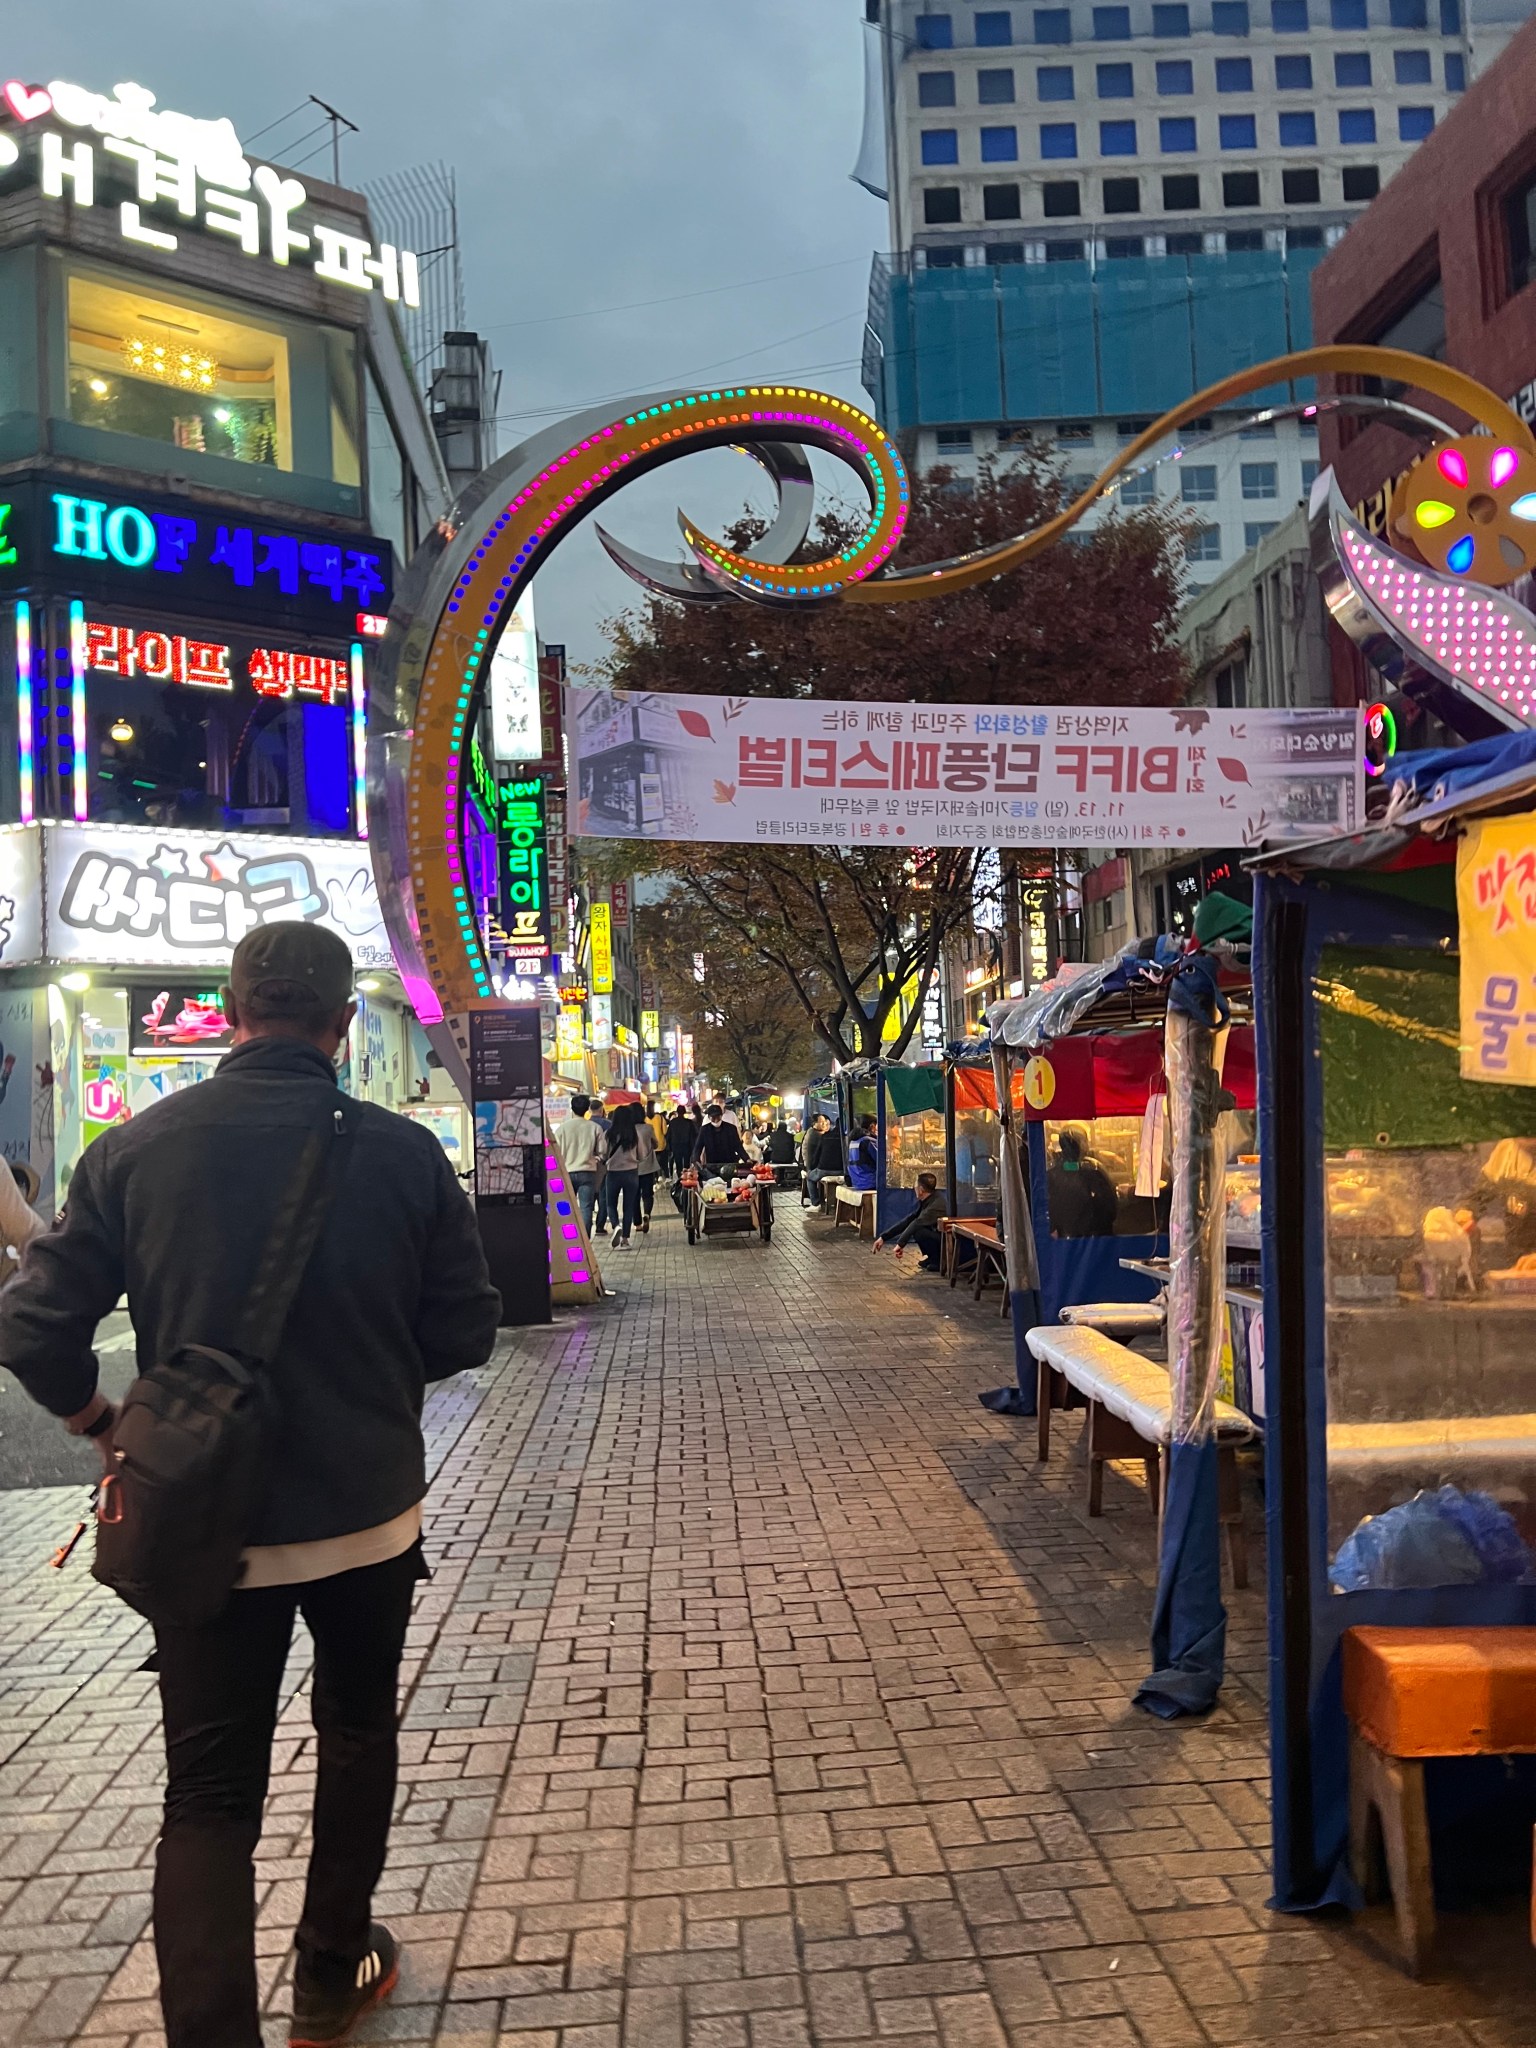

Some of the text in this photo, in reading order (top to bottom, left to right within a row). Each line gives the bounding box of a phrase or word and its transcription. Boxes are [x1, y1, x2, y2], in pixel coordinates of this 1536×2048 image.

[52, 493, 197, 573] HOF
[210, 525, 386, 607] 세계맥주
[500, 778, 541, 802] New
[502, 802, 545, 944] 롱라이프
[593, 906, 609, 975] 왕자사진관
[519, 960, 539, 973] 2F
[1033, 1069, 1044, 1095] 1
